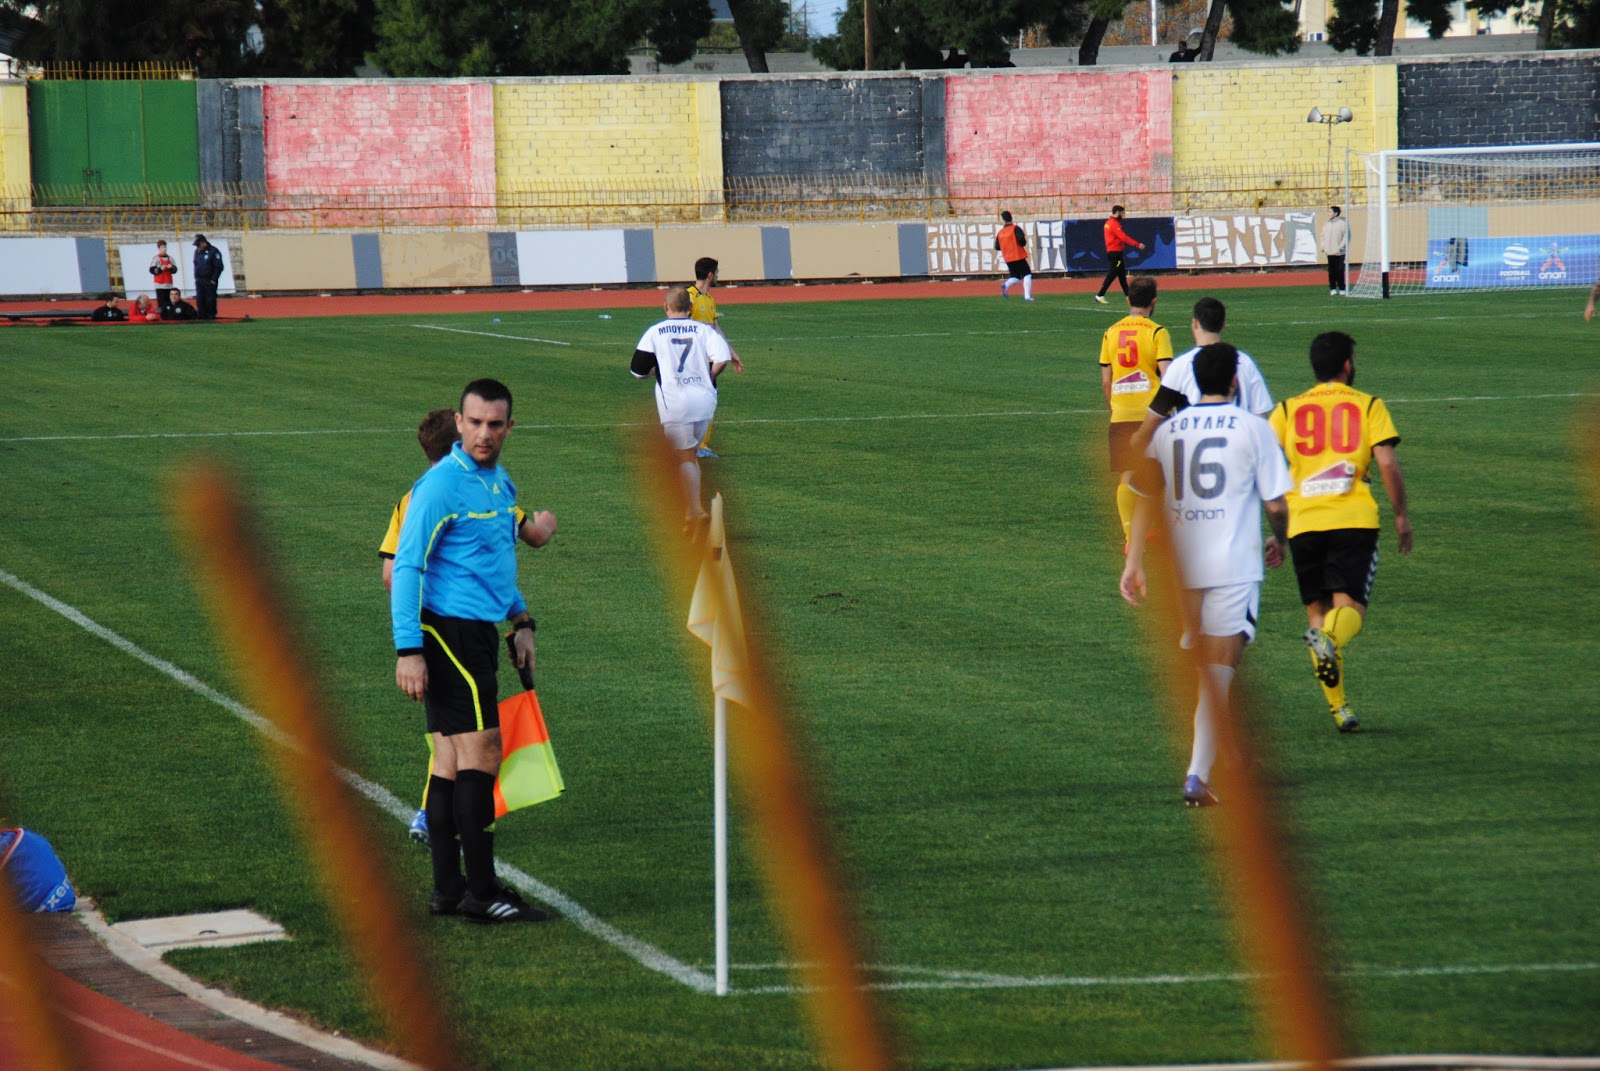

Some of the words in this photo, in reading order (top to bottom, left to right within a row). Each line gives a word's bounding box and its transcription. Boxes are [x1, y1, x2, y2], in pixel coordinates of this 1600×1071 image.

[658, 325, 698, 335] ΜΠΟΥΝΑΣ
[671, 338, 693, 373] 7
[1118, 330, 1139, 368] 5
[1113, 383, 1150, 392] OPINION
[1170, 416, 1238, 433] ΣΟΥΛΗΣ
[1295, 402, 1361, 457] 90
[1173, 437, 1228, 500] 16
